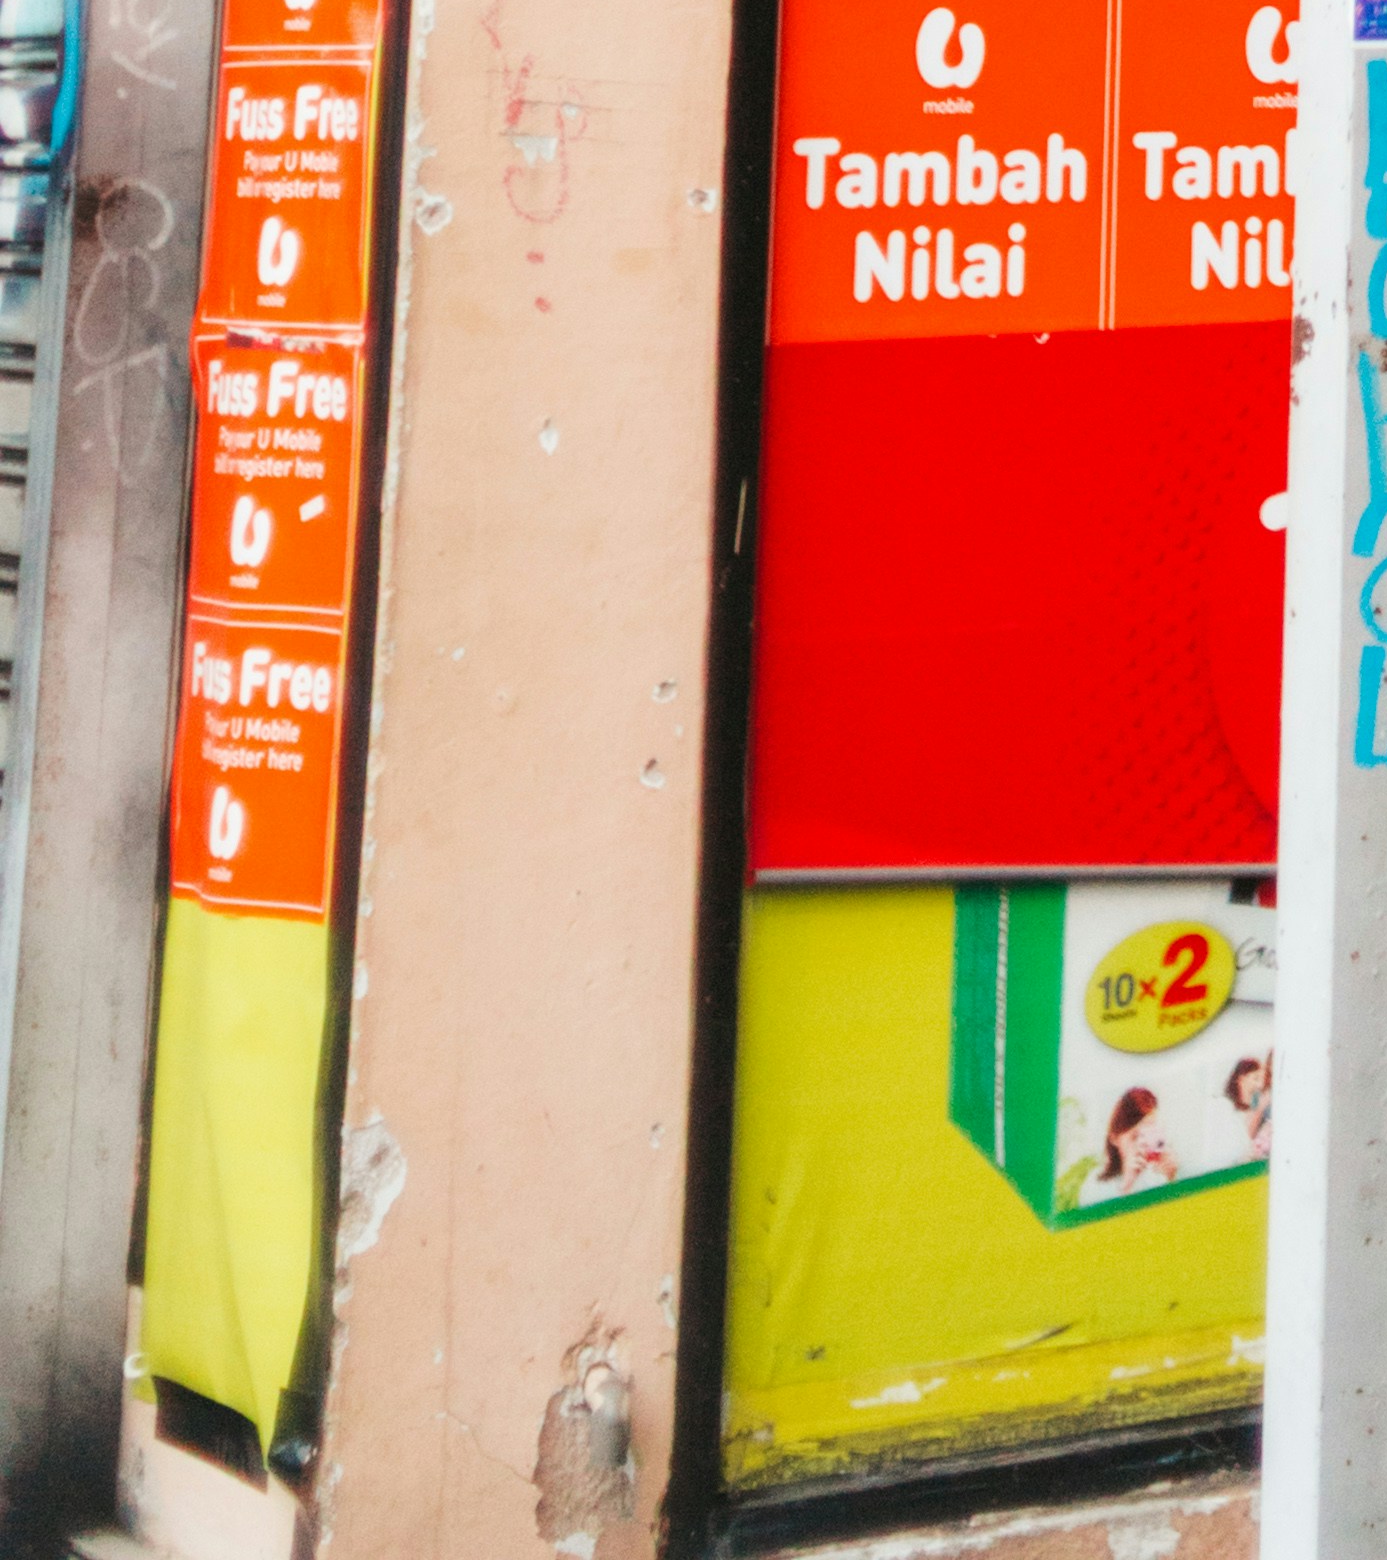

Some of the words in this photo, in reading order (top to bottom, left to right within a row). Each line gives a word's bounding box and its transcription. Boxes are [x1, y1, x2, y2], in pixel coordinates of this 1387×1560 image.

[225, 86, 284, 141] Fuss
[294, 84, 359, 141] Free
[922, 97, 974, 115] mobile
[793, 134, 1087, 211] Tambah
[1132, 128, 1299, 201] Tam
[852, 222, 1027, 303] Nilai
[1191, 216, 1294, 291] Nil
[267, 360, 348, 421] Free
[257, 428, 271, 450] U
[273, 428, 323, 452] Mobile
[239, 647, 332, 713] Free
[231, 718, 242, 740] U
[245, 716, 301, 745] Mobile
[268, 747, 303, 773] here
